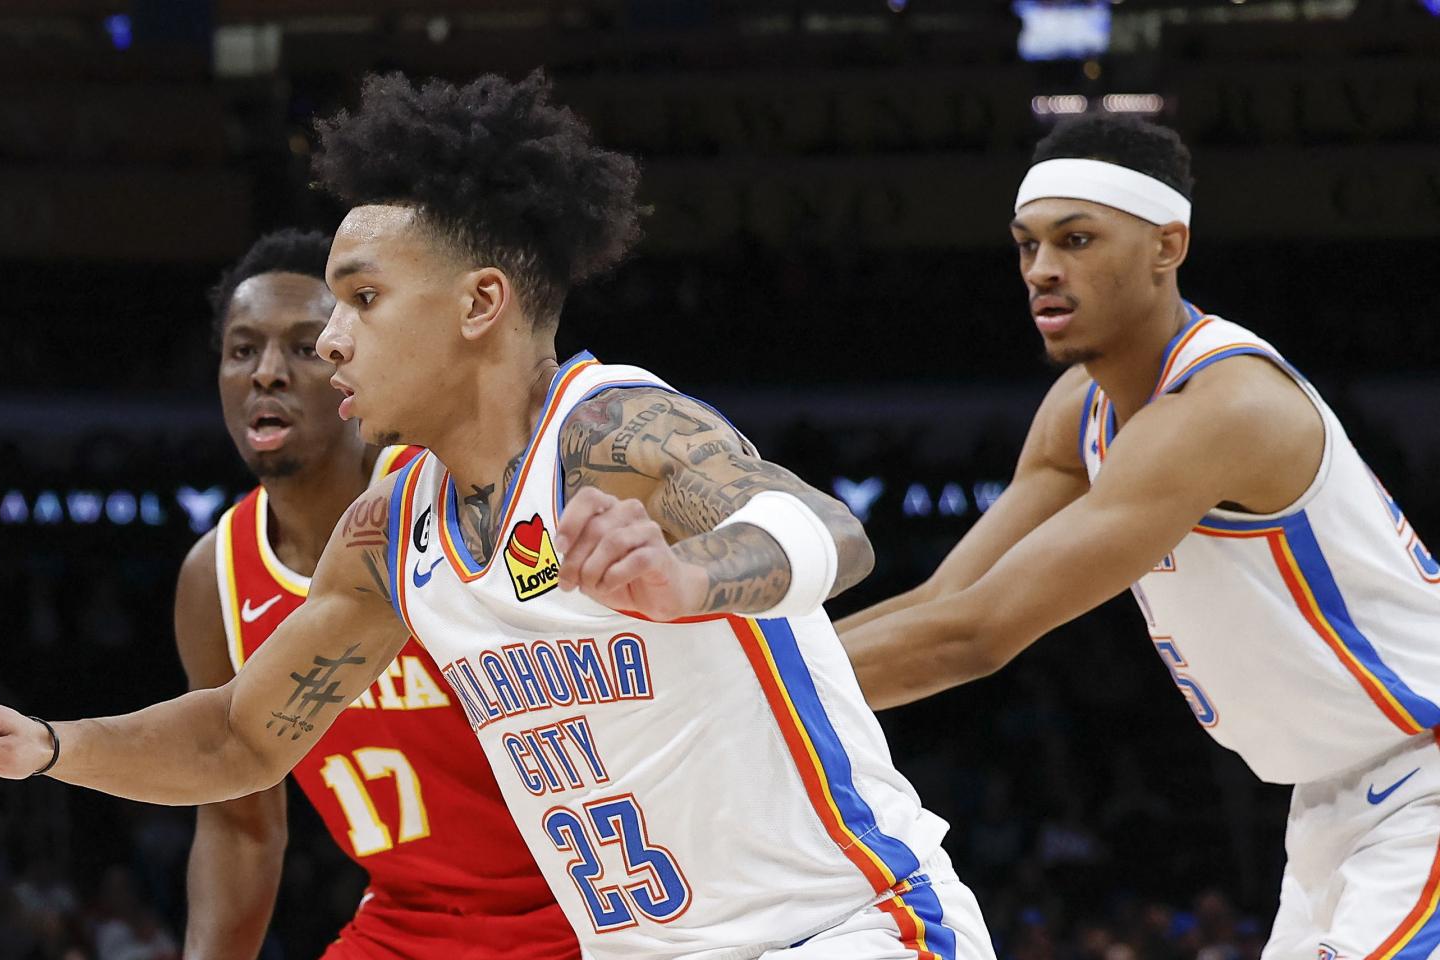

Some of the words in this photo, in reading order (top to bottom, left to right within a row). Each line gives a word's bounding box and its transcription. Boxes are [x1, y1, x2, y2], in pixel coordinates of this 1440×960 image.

[442, 632, 655, 734] KLAHOMA
[320, 747, 431, 858] 17
[502, 714, 610, 797] CITY
[542, 792, 693, 934] 23
